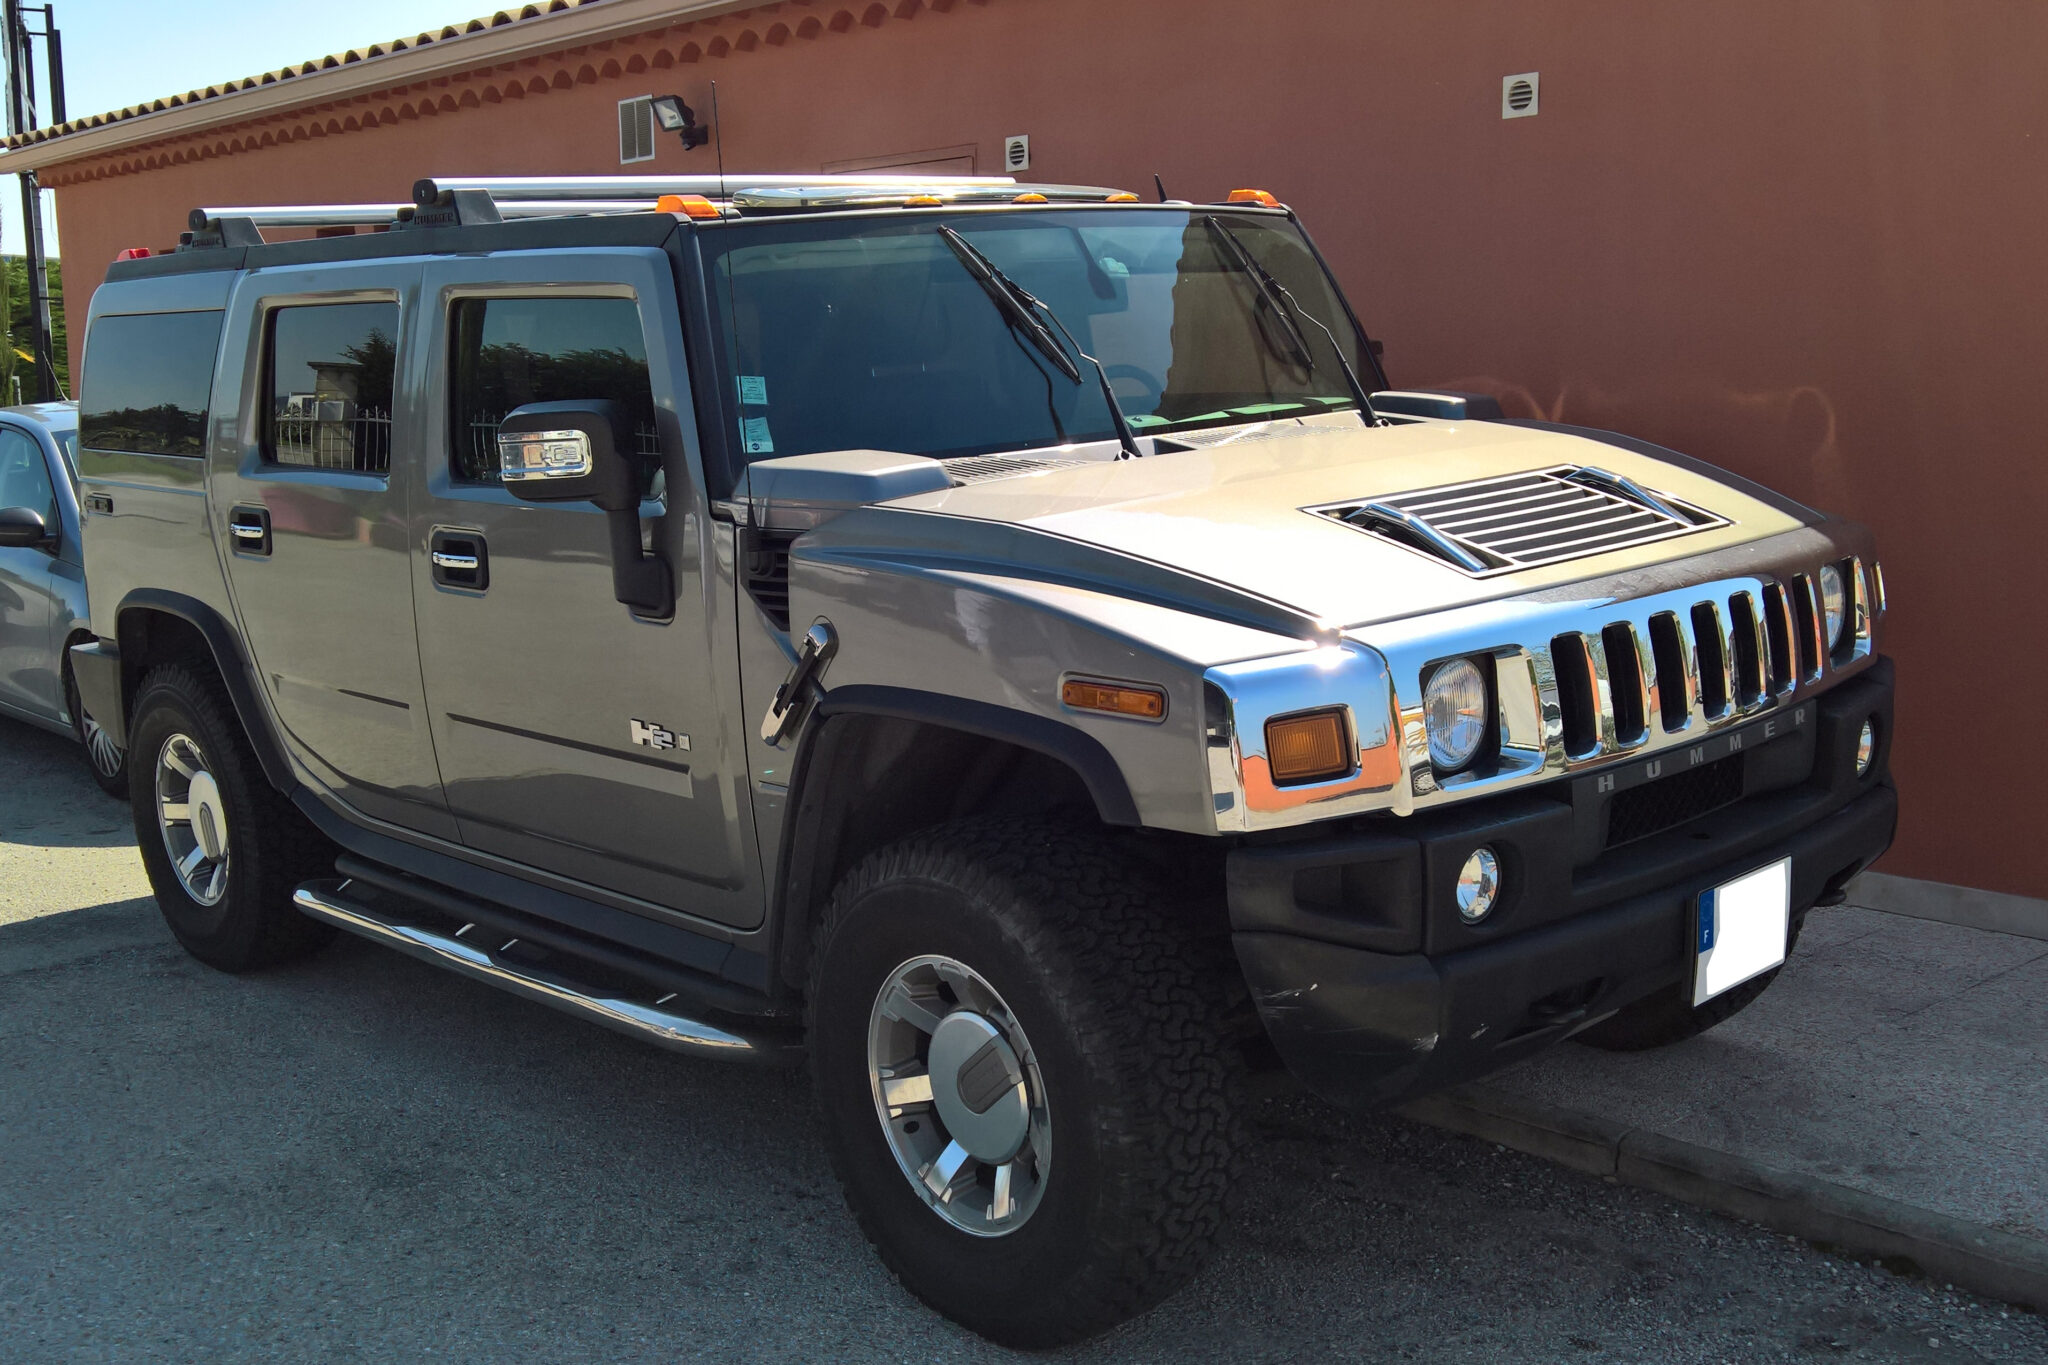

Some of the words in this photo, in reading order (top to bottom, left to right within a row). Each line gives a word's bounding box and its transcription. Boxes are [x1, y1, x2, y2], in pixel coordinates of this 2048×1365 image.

[630, 718, 676, 750] H2
[1597, 708, 1806, 793] HUMMER
[1703, 929, 1709, 944] F
